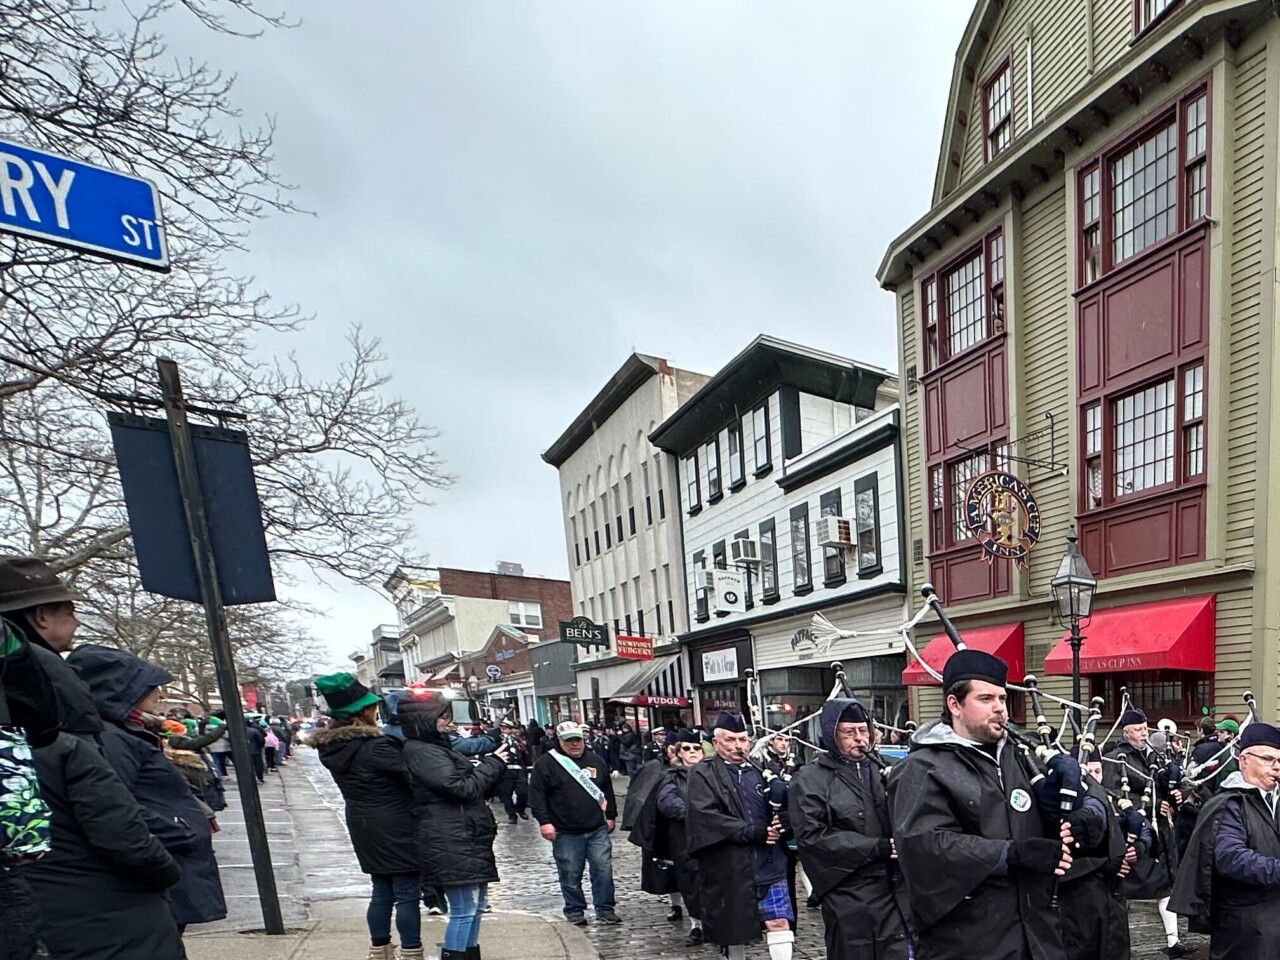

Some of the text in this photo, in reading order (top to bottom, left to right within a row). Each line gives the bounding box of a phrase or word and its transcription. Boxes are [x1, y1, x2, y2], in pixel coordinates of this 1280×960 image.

[0, 152, 153, 250] RY ST
[969, 474, 1040, 533] AMERICA'S CUP
[993, 544, 1020, 556] INN
[566, 628, 602, 639] BEN'S
[617, 640, 651, 648] NEWPORT
[618, 646, 651, 656] FUDGERY
[1108, 657, 1125, 669] CUP
[1126, 656, 1142, 667] INN
[648, 697, 680, 705] FUDGE
